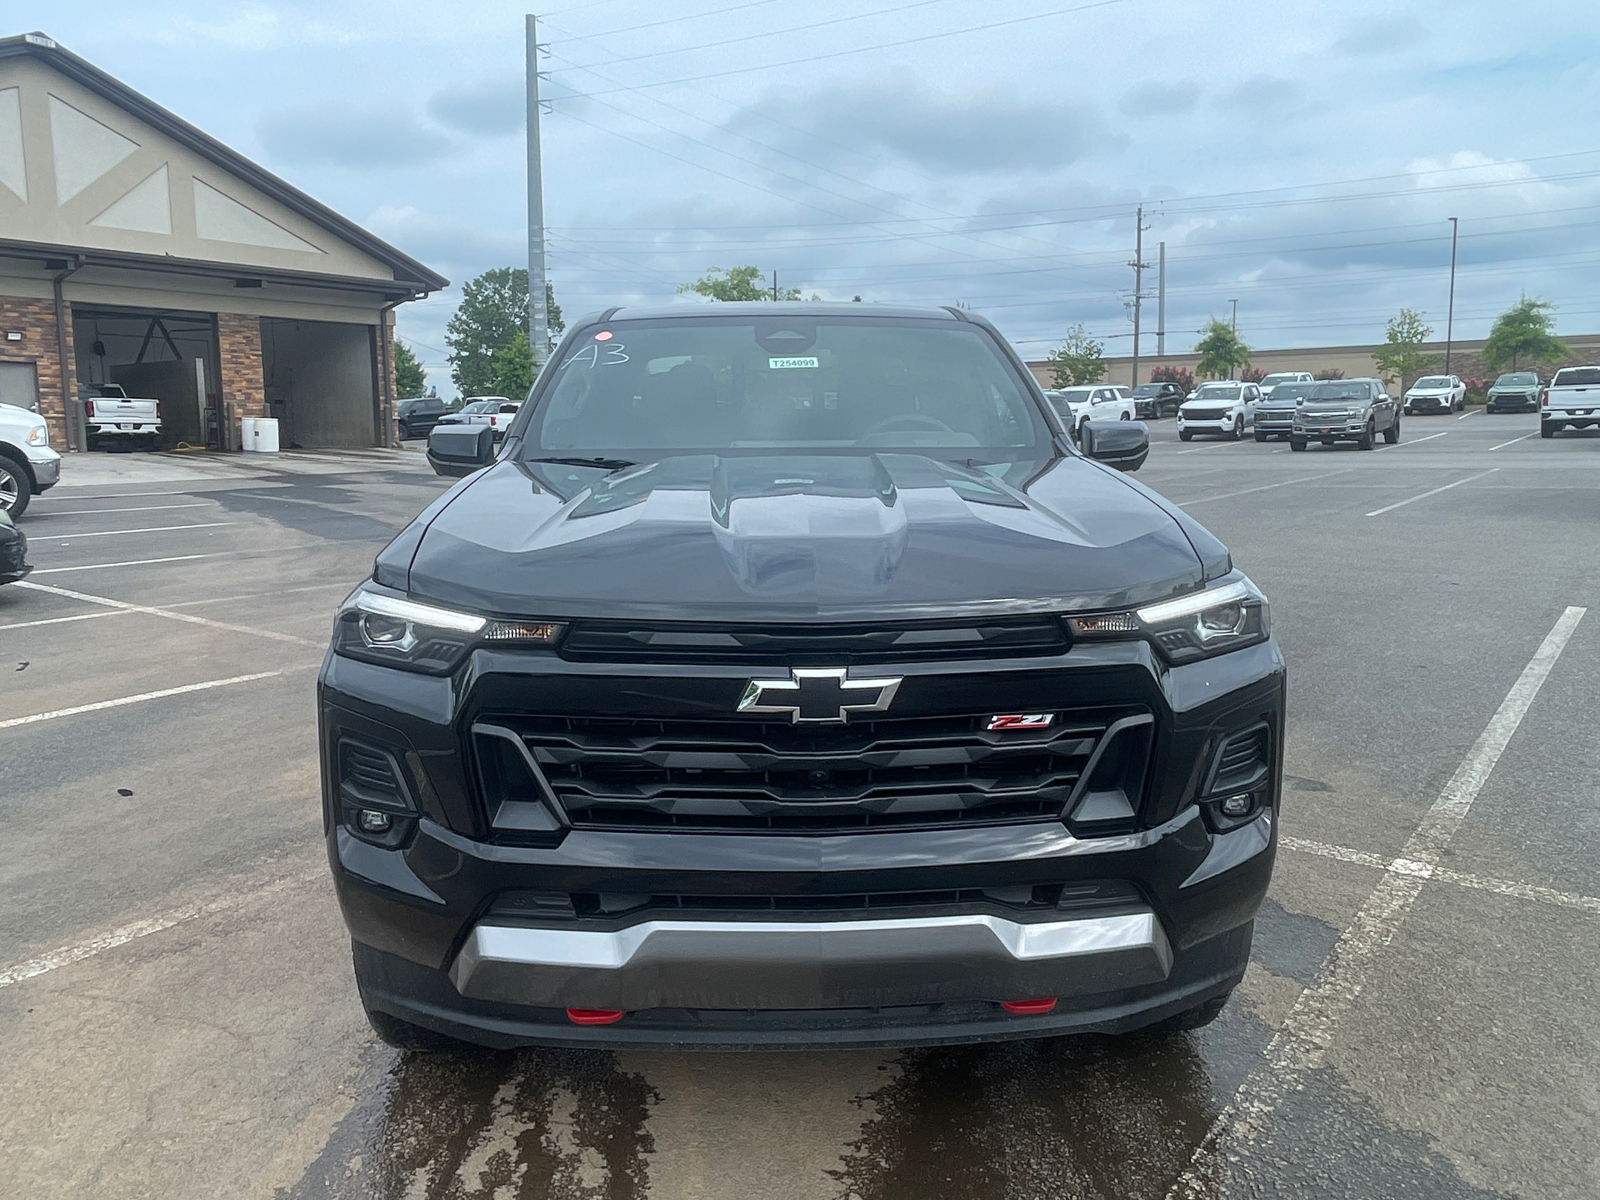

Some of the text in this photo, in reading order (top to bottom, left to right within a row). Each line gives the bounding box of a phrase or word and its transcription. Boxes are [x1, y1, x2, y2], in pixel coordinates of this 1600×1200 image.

[560, 343, 630, 370] A3
[772, 359, 815, 367] T254099
[987, 713, 1054, 730] Z71
